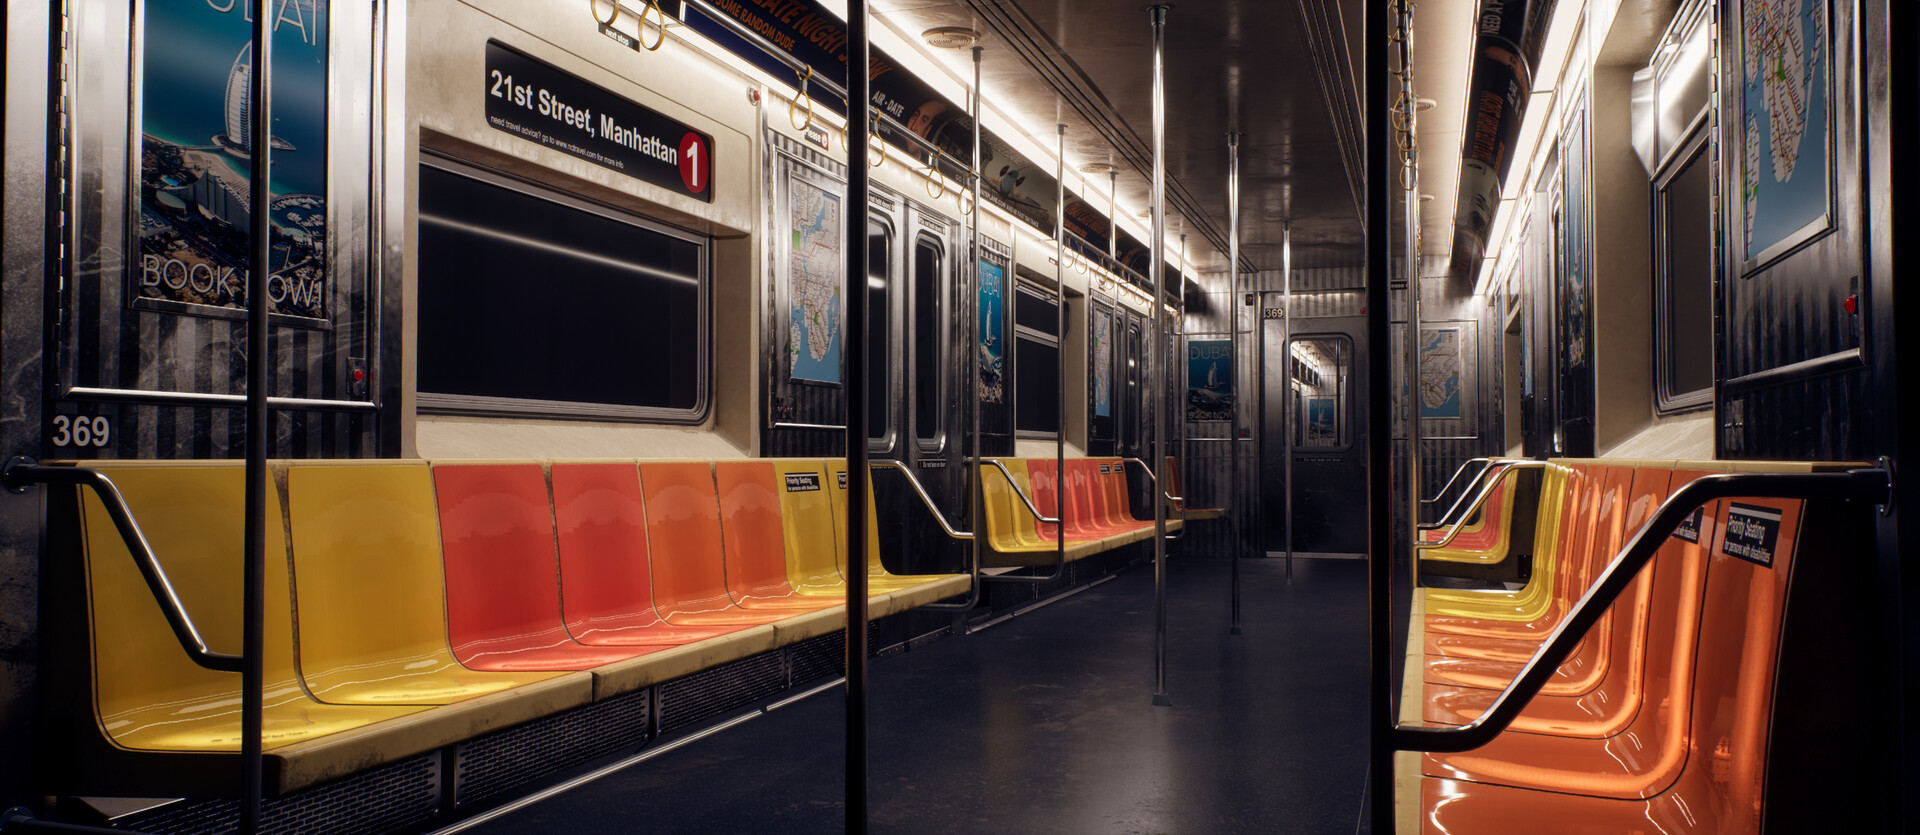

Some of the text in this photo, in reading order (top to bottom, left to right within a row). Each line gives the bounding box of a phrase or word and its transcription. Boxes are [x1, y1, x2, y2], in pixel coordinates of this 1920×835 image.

[752, 0, 804, 25] ATE
[605, 29, 629, 46] next stop
[740, 8, 775, 40] RANDOM
[774, 31, 796, 52] DUDE
[872, 90, 886, 106] AIR
[886, 99, 905, 118] DATE
[490, 115, 505, 127] need
[505, 120, 521, 132] travel
[521, 126, 541, 140] advice?
[541, 134, 549, 143] go
[549, 136, 555, 145] to
[596, 152, 604, 162] for
[603, 156, 616, 167] more
[491, 69, 698, 187] 21st Street, Manhattan 1
[143, 254, 322, 309] BOOK OW!
[1265, 308, 1283, 318] 369
[1190, 346, 1230, 360] DUBA
[52, 415, 109, 447] 369
[1727, 515, 1745, 540] Priority
[1744, 518, 1766, 545] Seating
